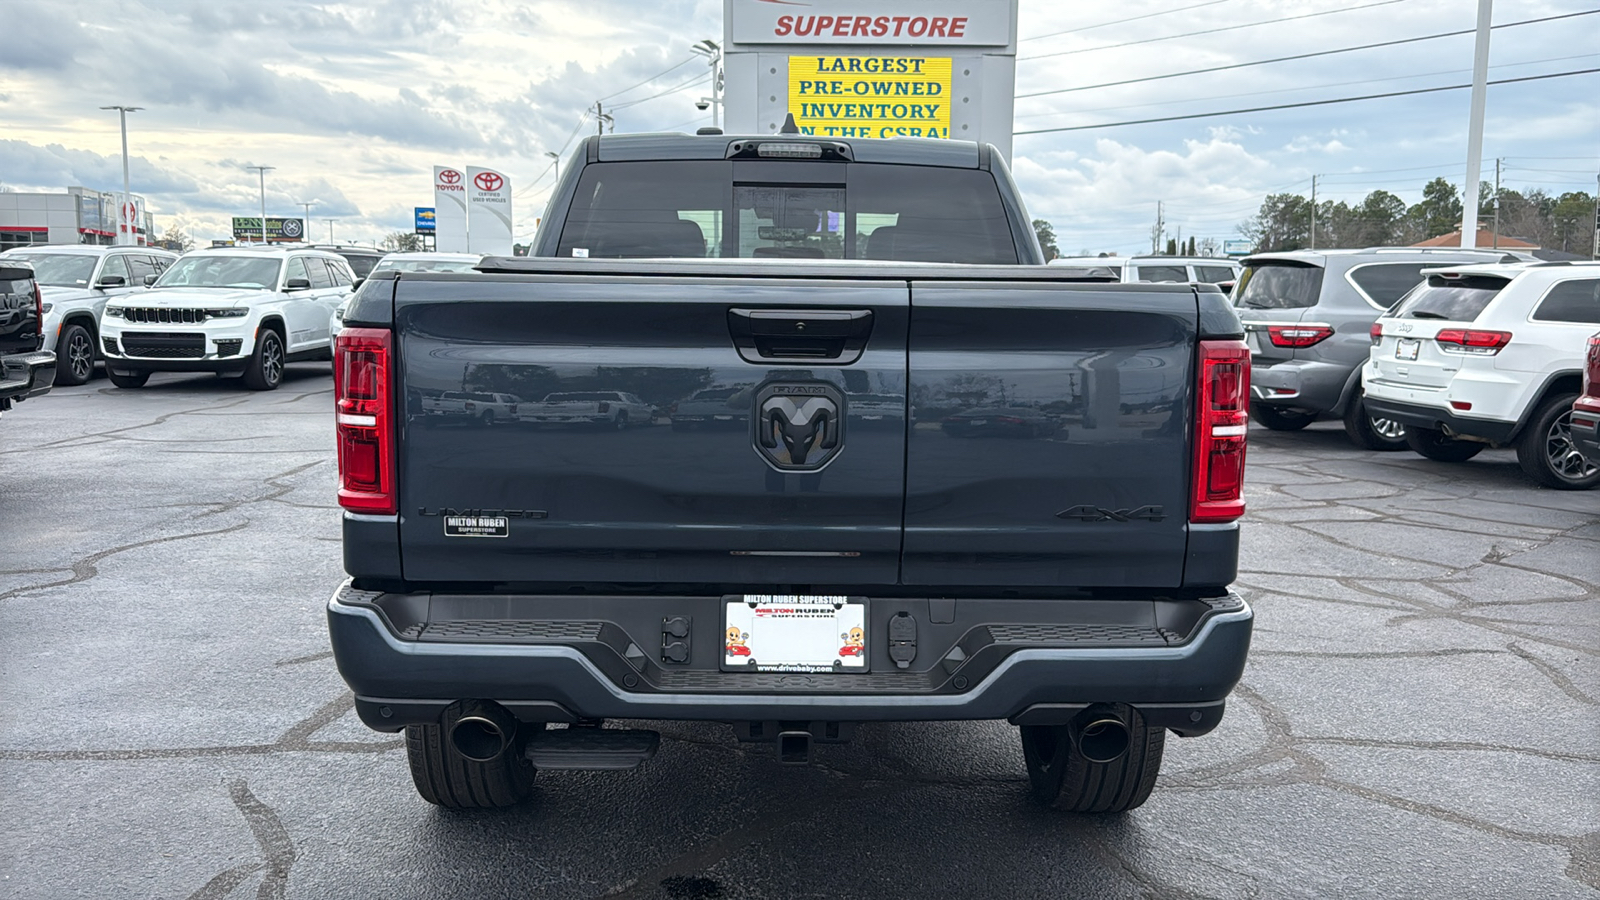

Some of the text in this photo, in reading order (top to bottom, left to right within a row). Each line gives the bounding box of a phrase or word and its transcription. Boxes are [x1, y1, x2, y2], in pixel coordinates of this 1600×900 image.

[774, 16, 967, 37] SUPERSTORE
[817, 57, 926, 73] LARGEST
[799, 80, 943, 96] PRE-OWNED
[800, 102, 941, 119] INVENTORY
[824, 126, 871, 138] THE
[435, 184, 465, 192] TOYOTA
[418, 507, 548, 518] LIMITED
[448, 517, 505, 528] MILTON RUBEN
[744, 595, 848, 604] MILTON RUBEN SUPERSTORE
[757, 664, 833, 673] www.drivebaby.com
